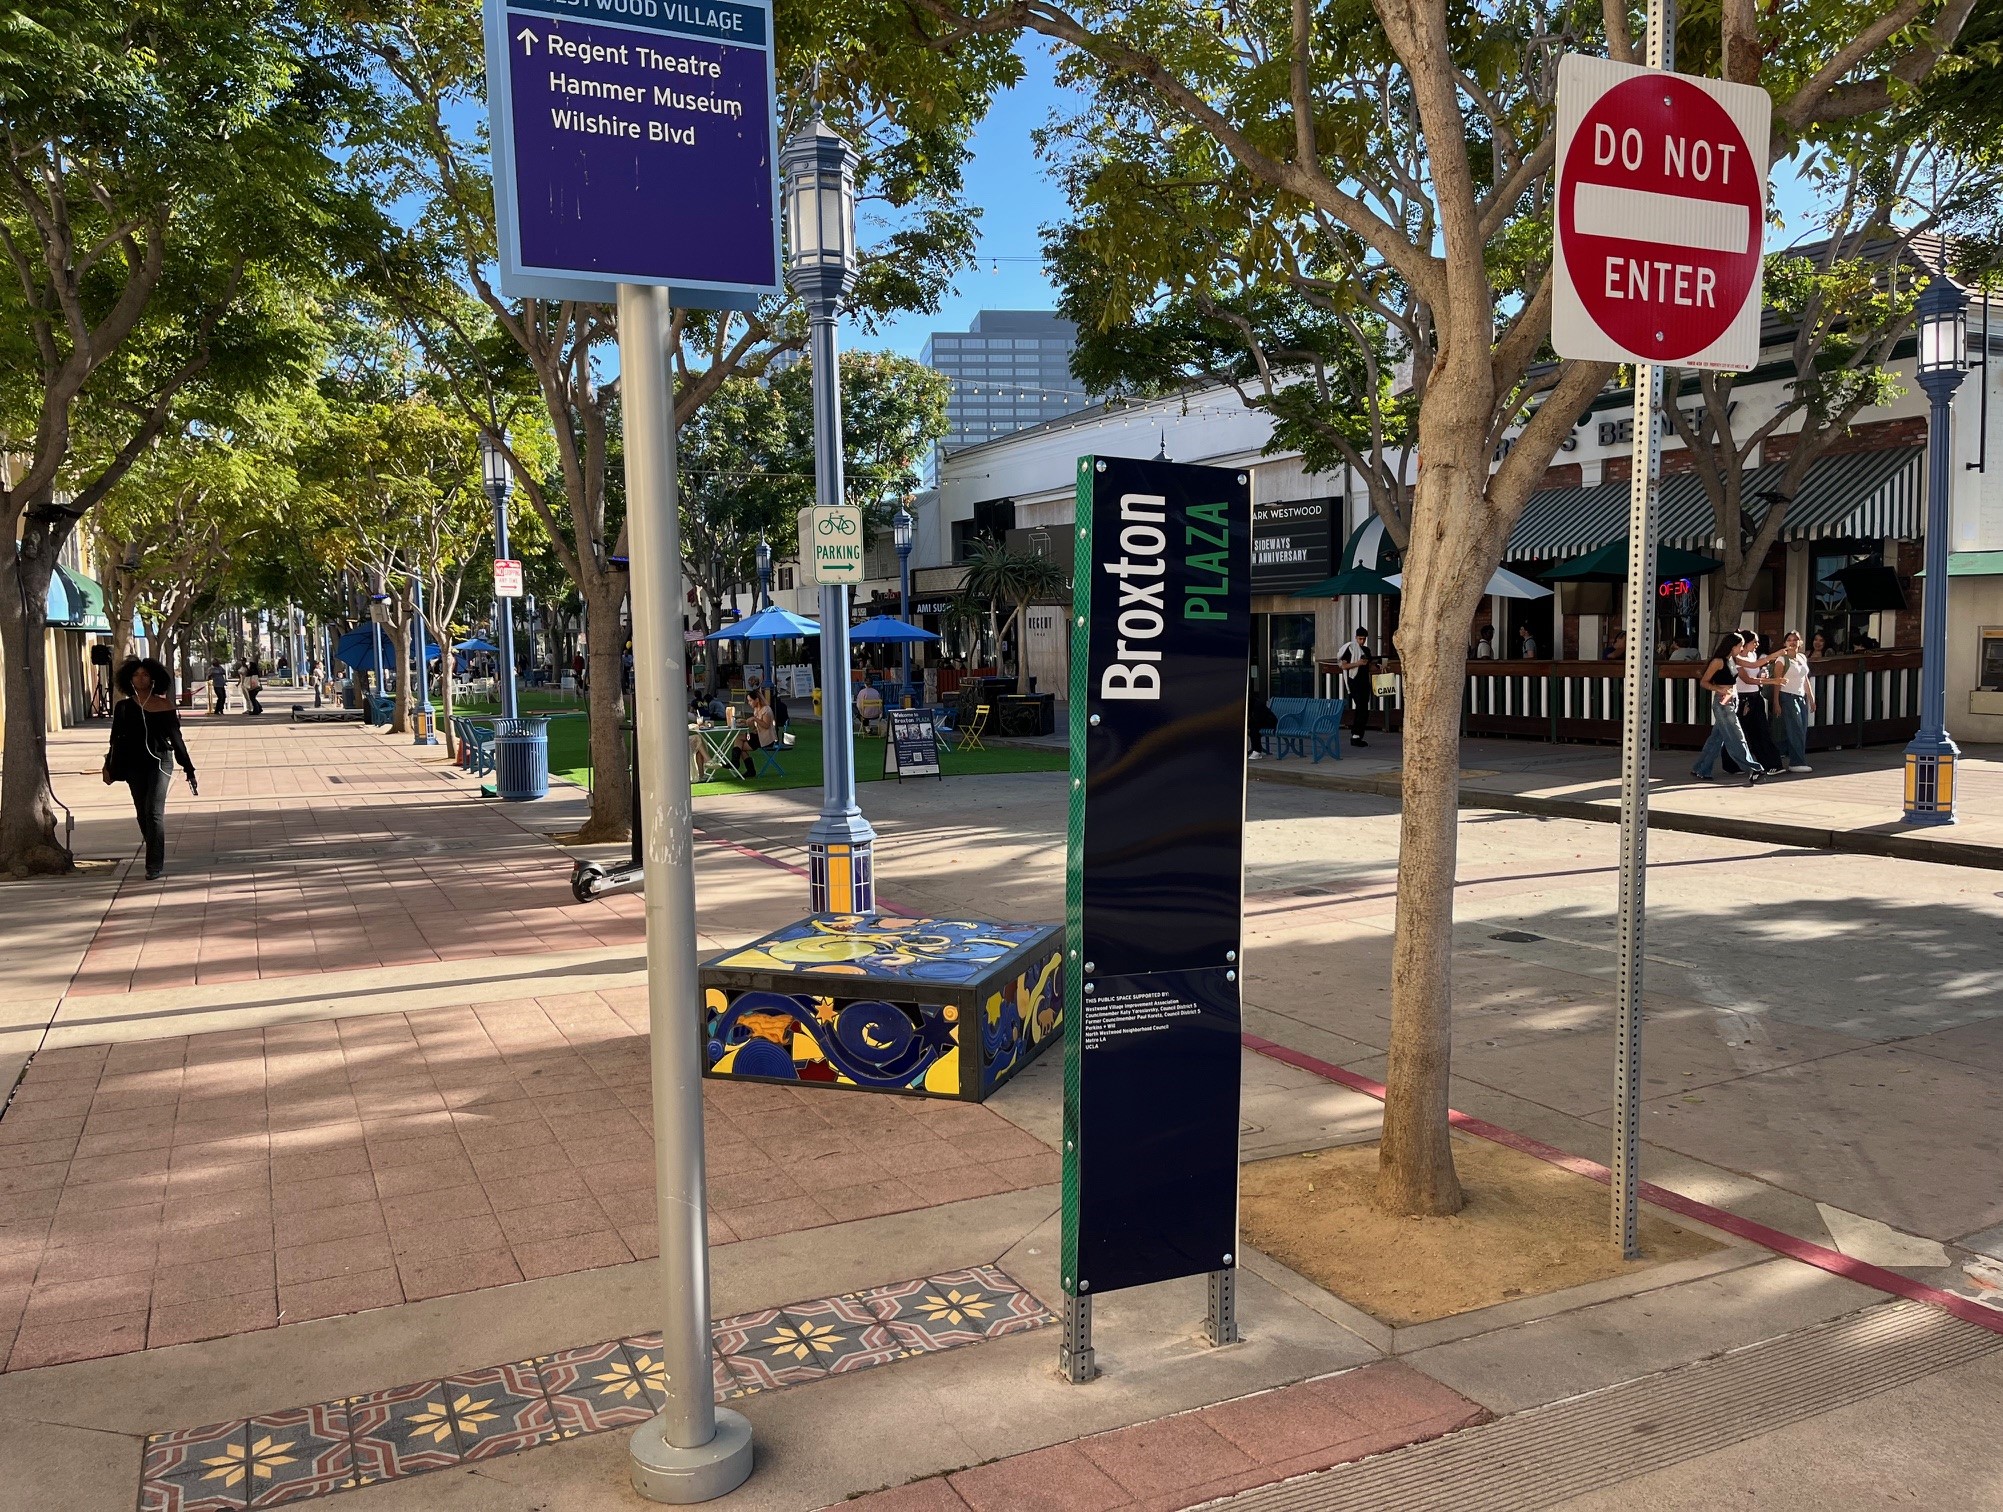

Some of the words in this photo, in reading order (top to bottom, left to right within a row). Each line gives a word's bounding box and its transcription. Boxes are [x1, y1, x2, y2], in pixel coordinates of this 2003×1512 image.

[546, 0, 658, 18] WOOD
[663, 2, 744, 32] VILLAGE
[548, 34, 629, 64] Regent
[636, 47, 721, 79] Theatre
[549, 71, 647, 104] Hammer
[653, 86, 743, 117] Museum
[551, 108, 641, 139] Wilshire
[649, 121, 696, 146] Blvd
[1594, 122, 1643, 171] DO
[1664, 135, 1736, 185] NOT
[1605, 256, 1716, 308] ENTER
[1252, 510, 1268, 520] ARK
[1270, 505, 1322, 518] WESTWOOD
[816, 545, 860, 560] PARKING
[1254, 537, 1290, 551] SIDEWAYS
[1258, 549, 1307, 564] ANNIVERSARY
[1184, 501, 1229, 620] PLAZA
[917, 604, 931, 613] AMI
[933, 603, 954, 612] SUS
[1101, 493, 1167, 700] Broxton
[1378, 686, 1396, 694] CAVA
[1133, 992, 1161, 1000] SUPPORTED
